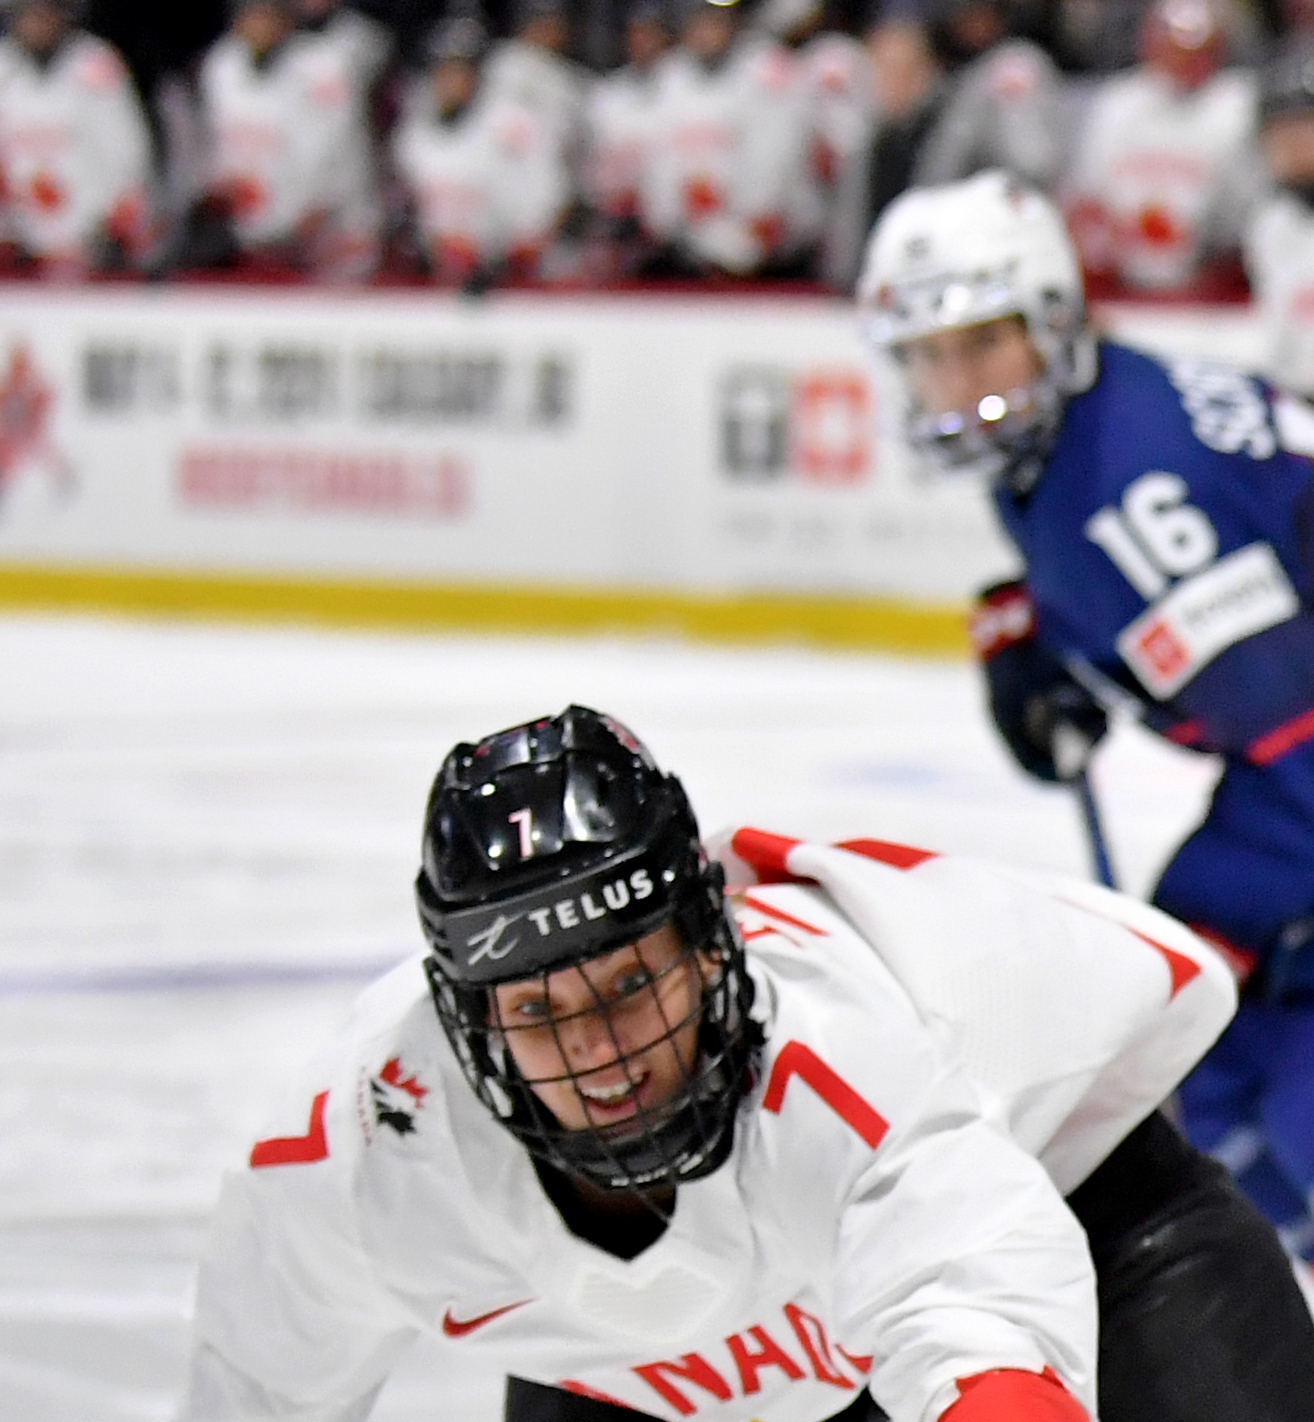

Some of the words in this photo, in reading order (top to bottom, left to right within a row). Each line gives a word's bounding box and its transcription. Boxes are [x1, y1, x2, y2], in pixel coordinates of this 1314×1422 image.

[1085, 470, 1219, 603] 16
[508, 806, 535, 862] 7
[528, 868, 655, 937] TELUS
[762, 1039, 891, 1151] 7
[558, 1302, 874, 1417] NAD
